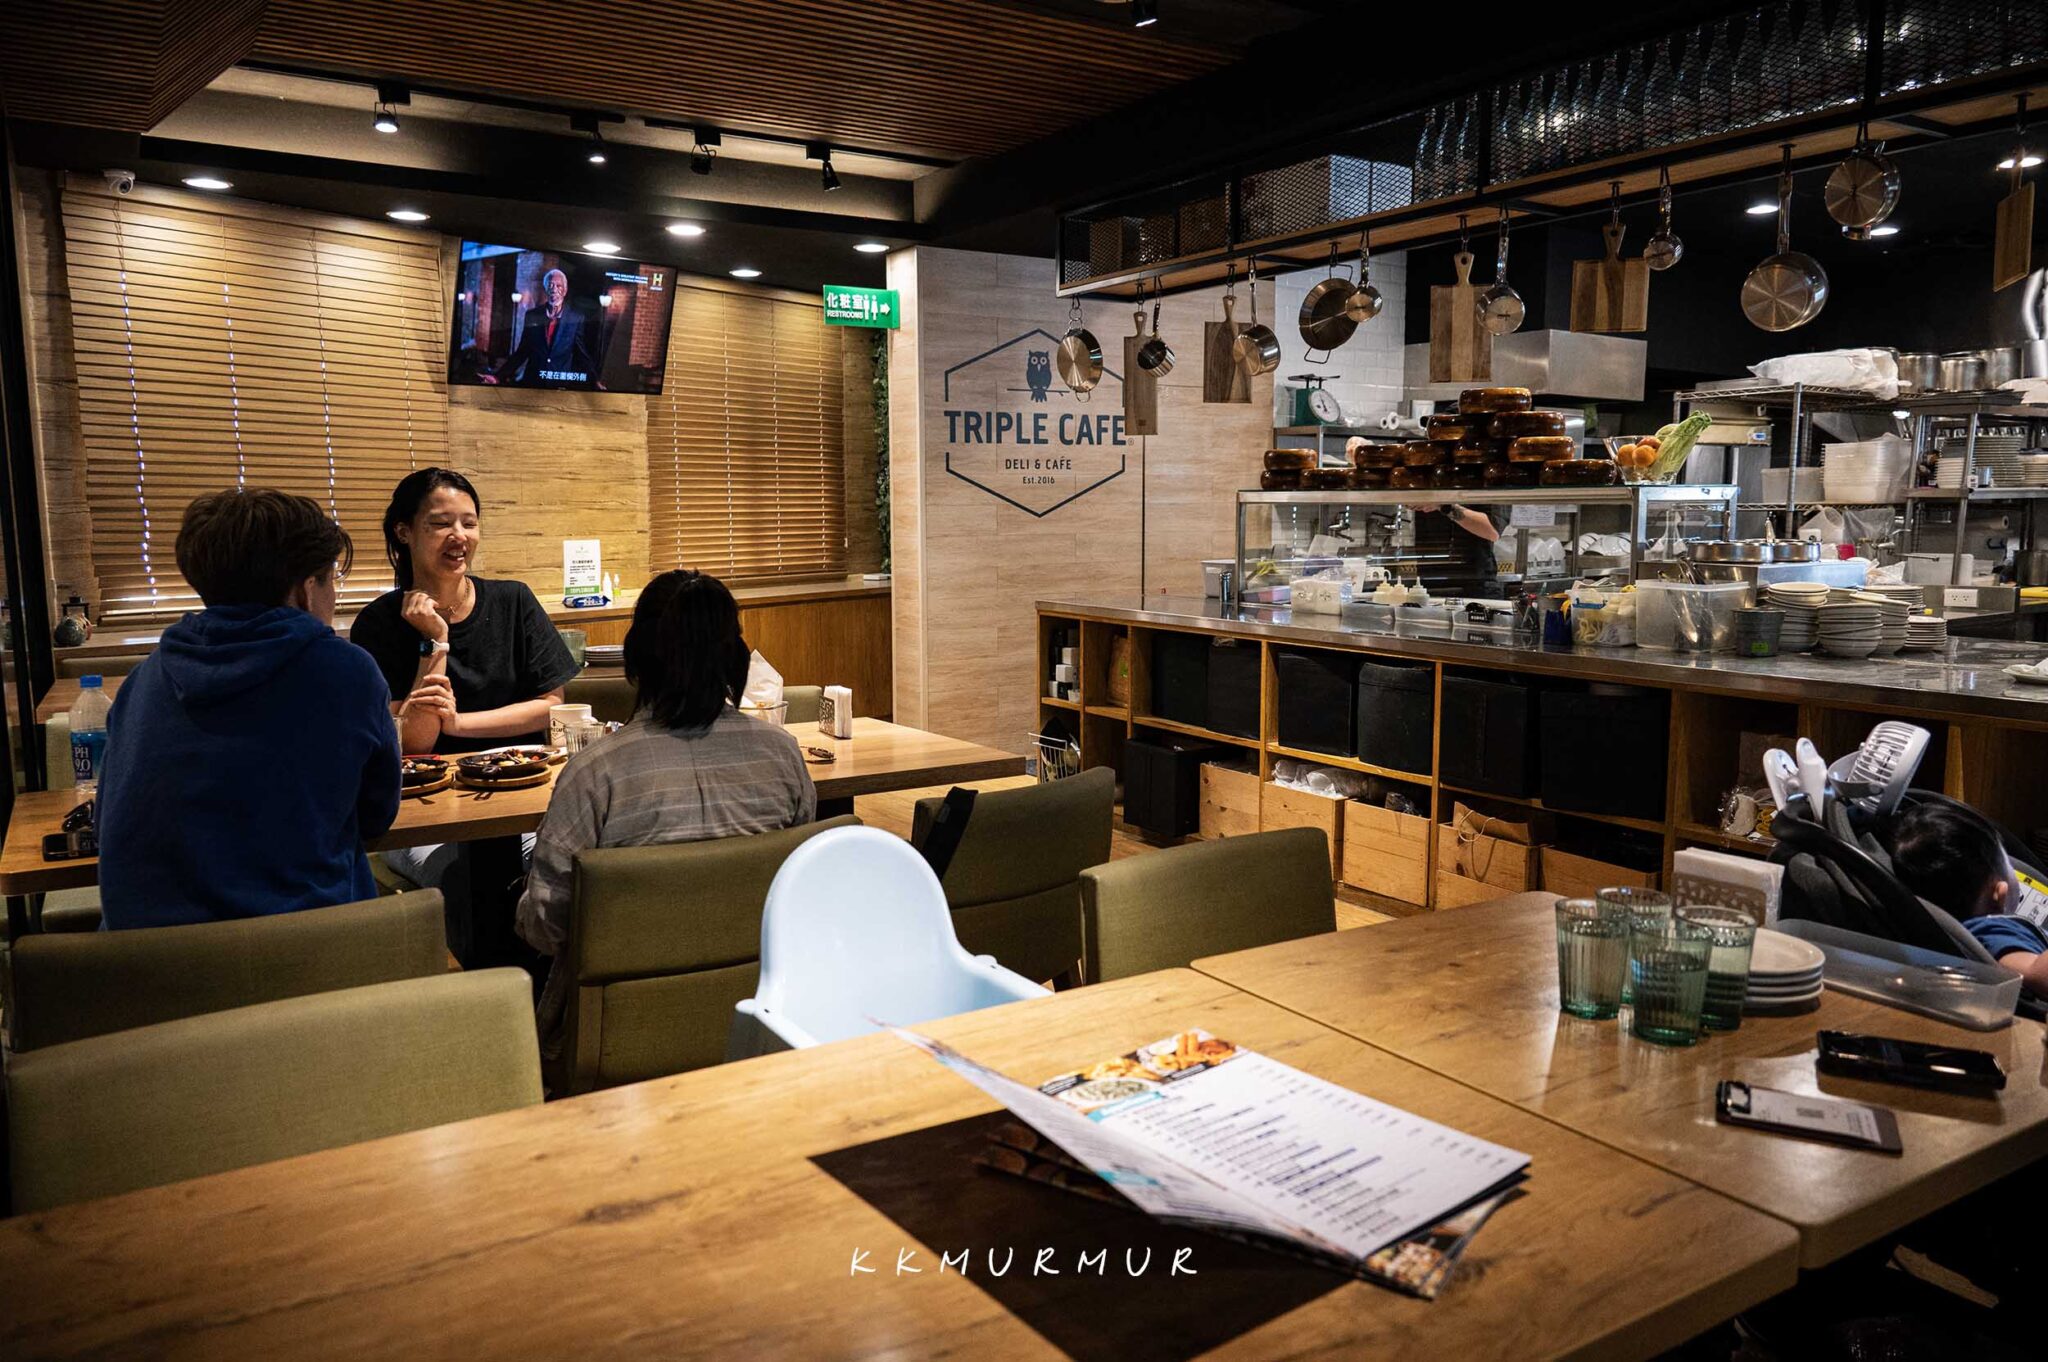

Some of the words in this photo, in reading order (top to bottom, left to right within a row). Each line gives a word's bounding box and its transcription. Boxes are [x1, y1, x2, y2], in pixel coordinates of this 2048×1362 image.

[826, 291, 864, 310] 化粧室
[826, 309, 864, 319] RESTROOMS
[944, 410, 1049, 444] TRIPLE
[1058, 413, 1127, 446] CAFE
[1005, 458, 1030, 470] DELI
[1034, 458, 1041, 470] &
[74, 746, 89, 758] PH
[74, 758, 91, 771] 9.0
